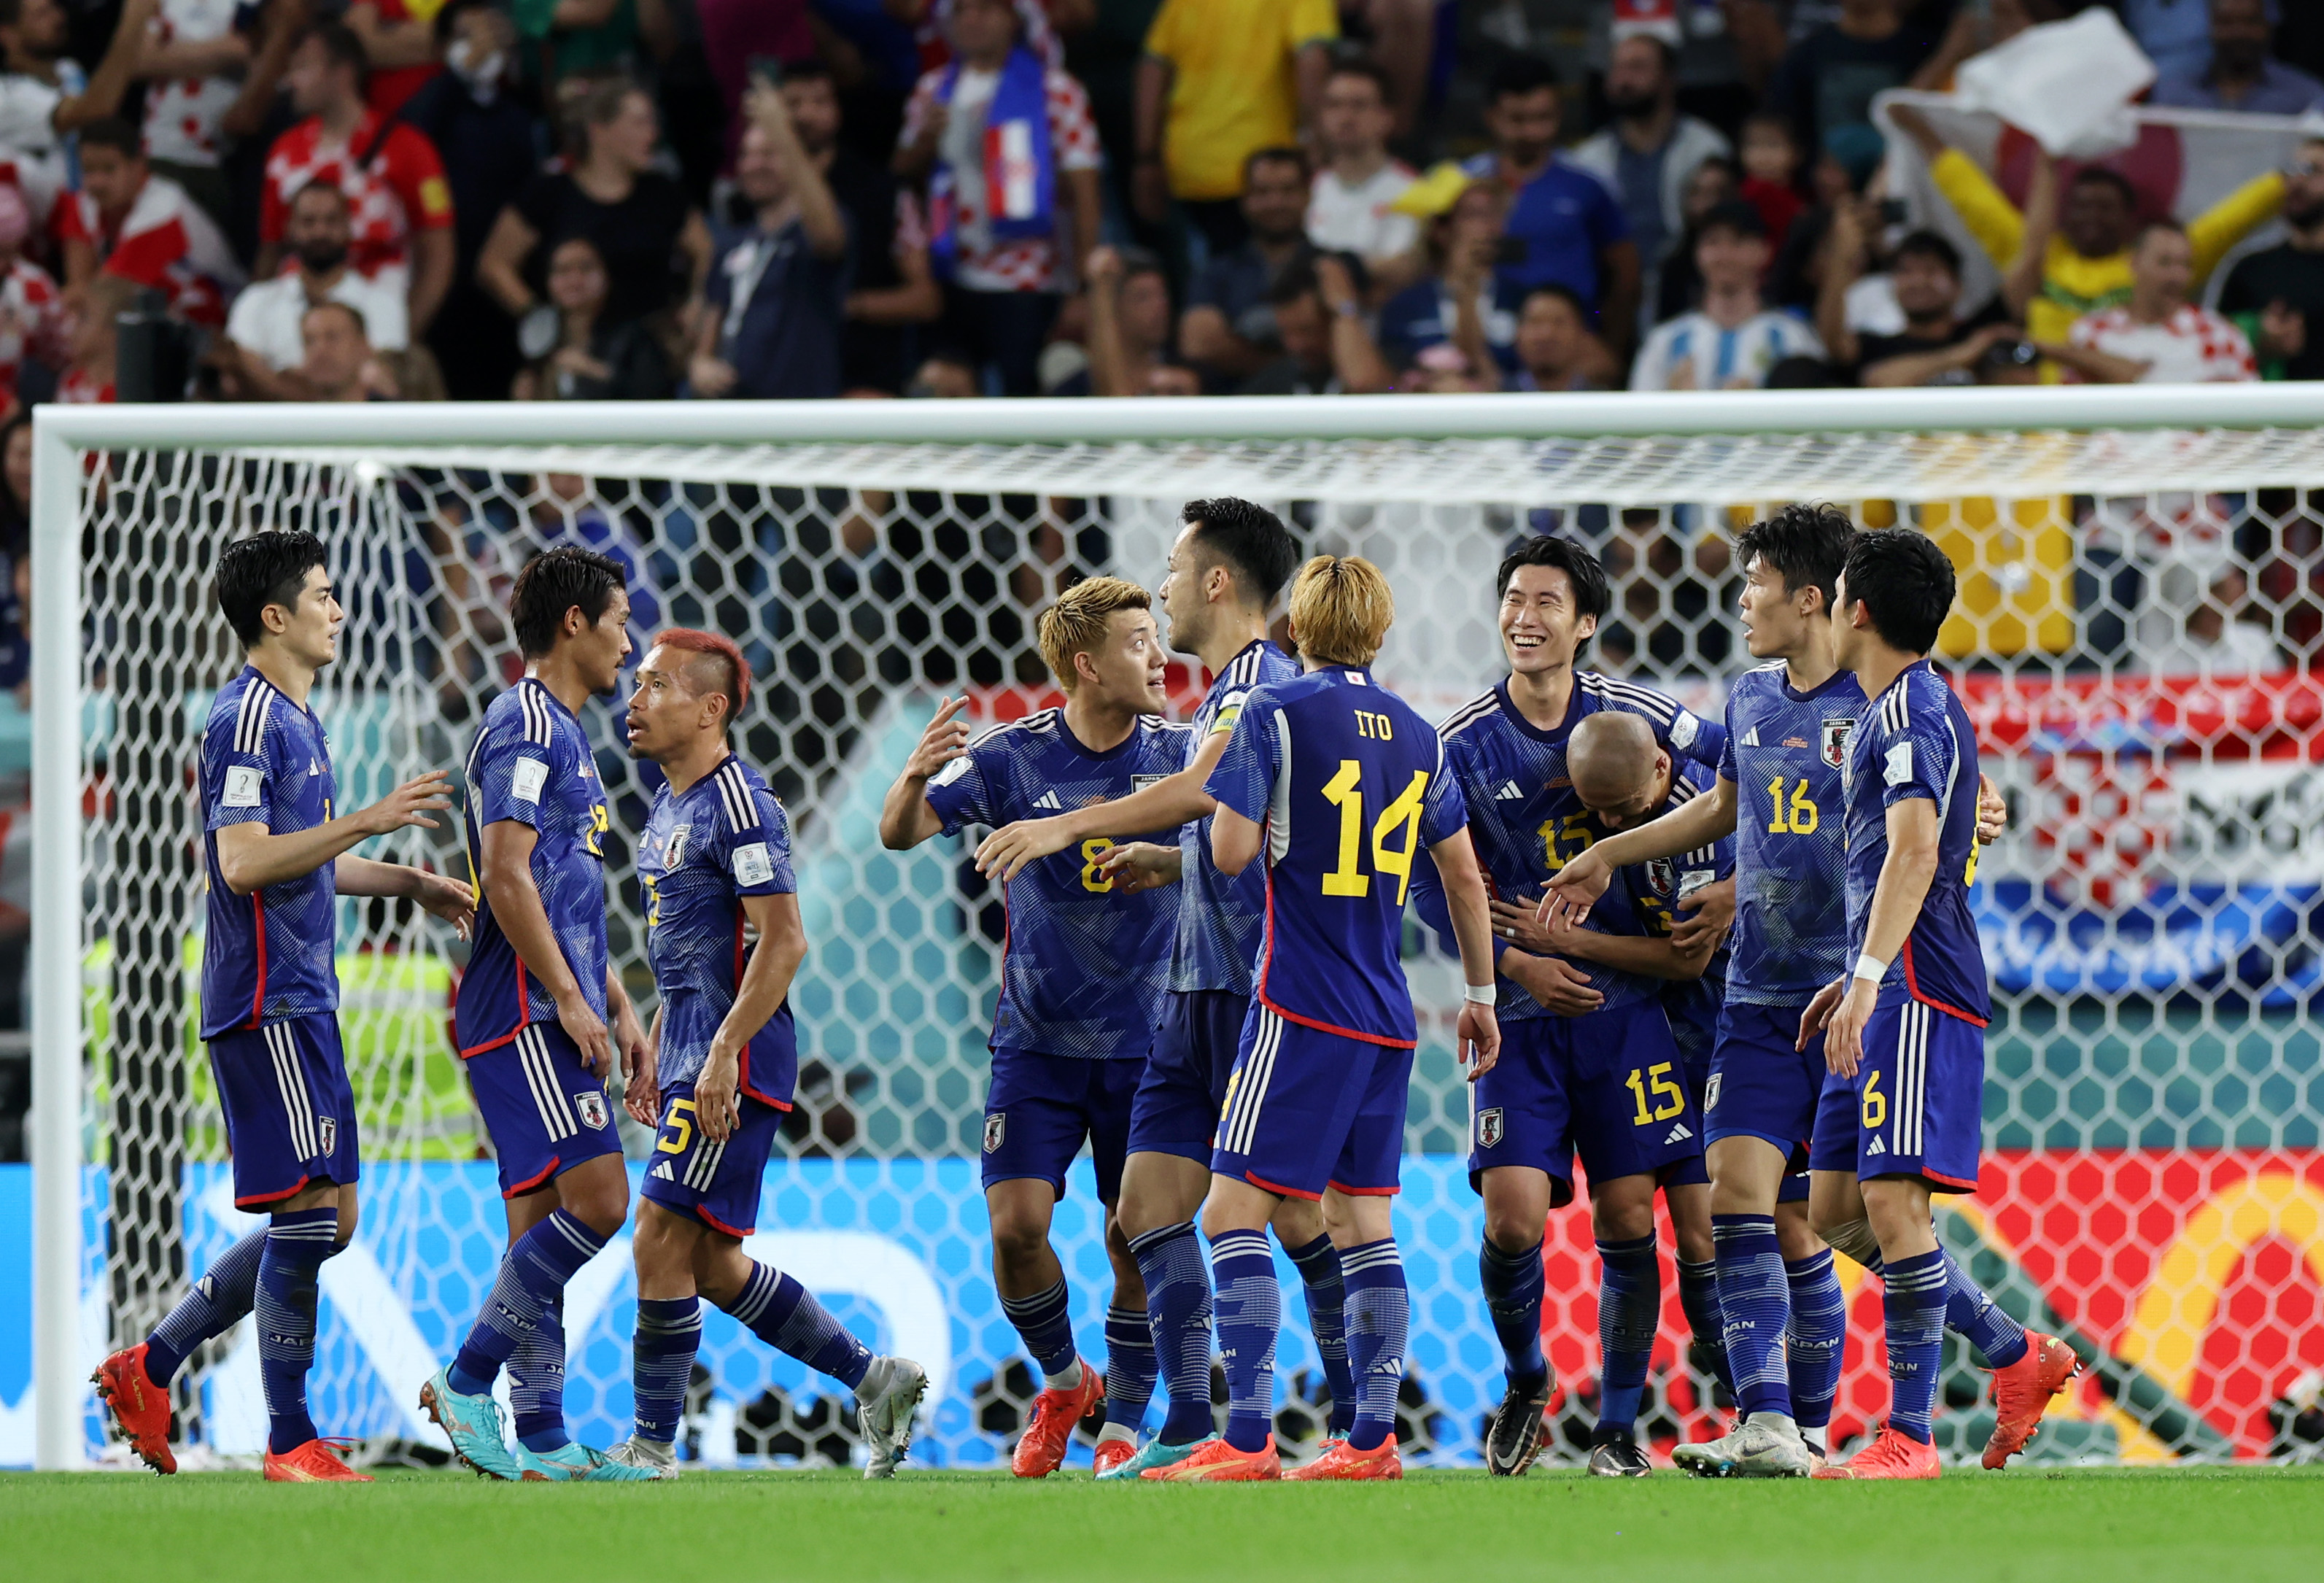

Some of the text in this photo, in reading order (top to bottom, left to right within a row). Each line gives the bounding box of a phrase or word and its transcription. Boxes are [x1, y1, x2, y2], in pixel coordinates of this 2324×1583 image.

[1354, 709, 1394, 741] ITO
[1320, 759, 1430, 906] 14
[1767, 776, 1818, 835] 16
[1082, 838, 1115, 893] 8
[1536, 809, 1594, 870] 15
[1624, 1061, 1686, 1126] 15
[1862, 1070, 1886, 1129] 6
[656, 1098, 696, 1155] 5
[497, 1307, 537, 1331] JAP
[1723, 1320, 1756, 1336] PAN
[1888, 1359, 1918, 1371] PAN
